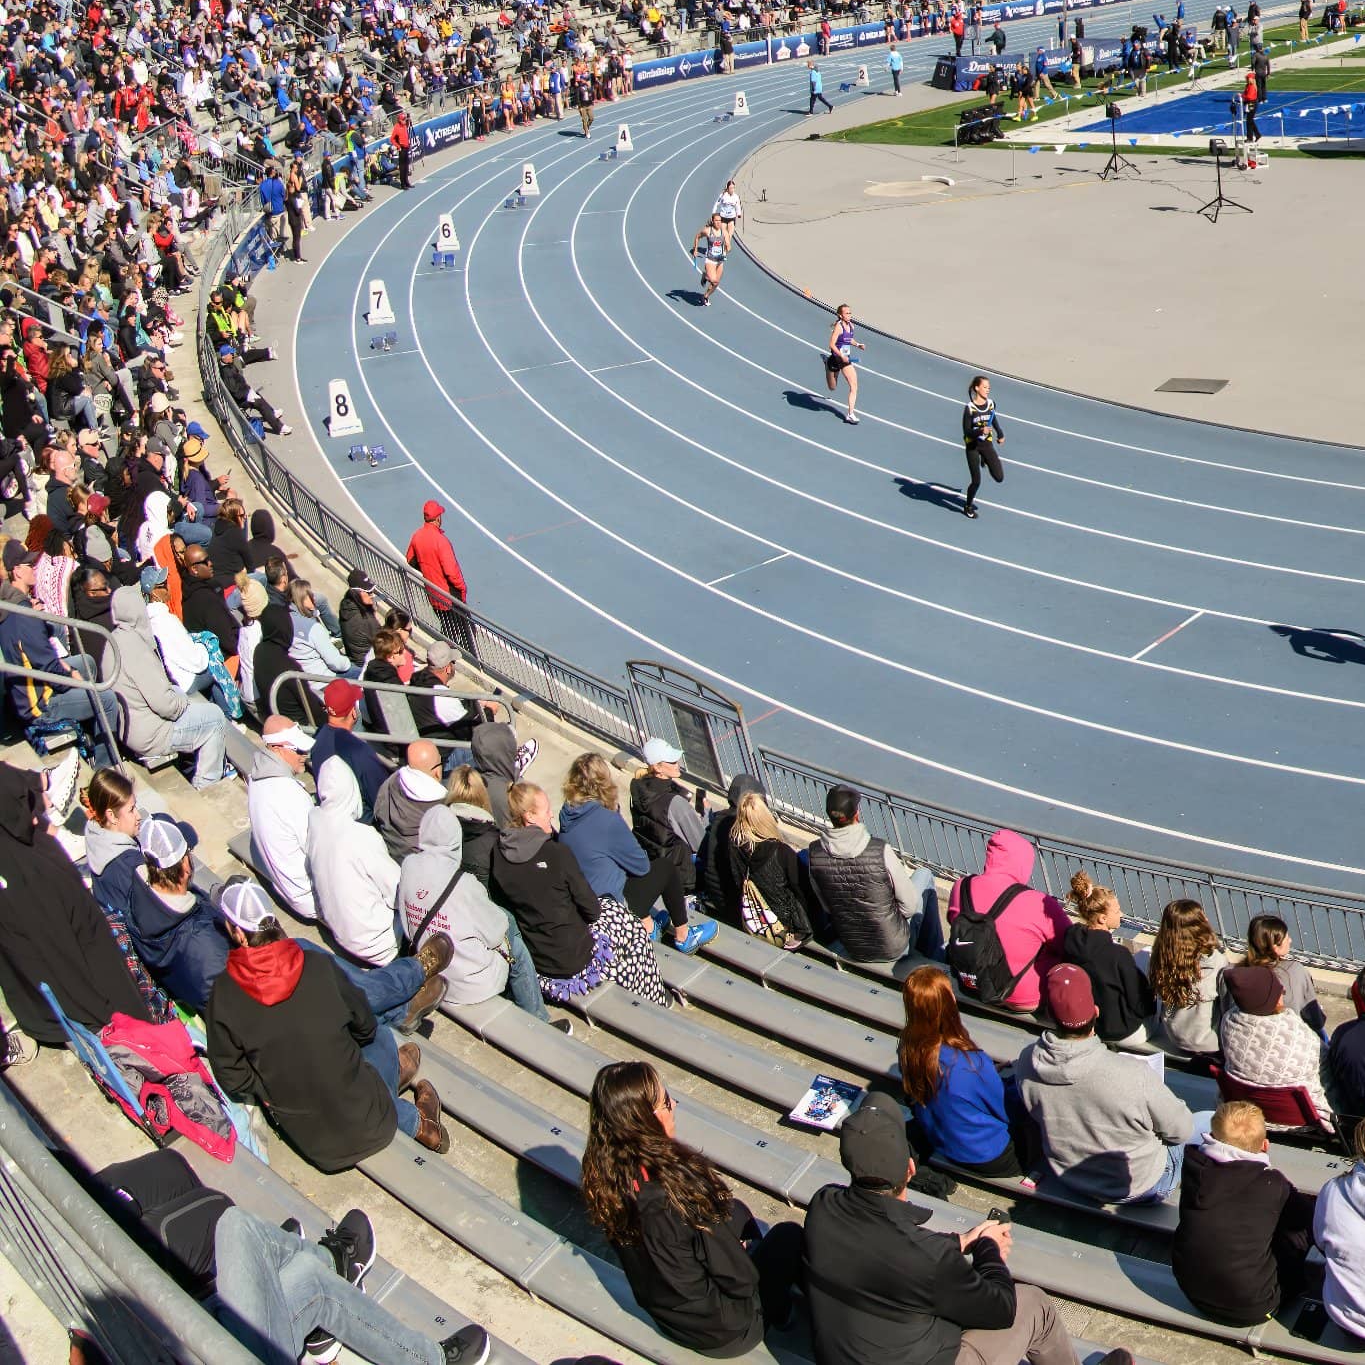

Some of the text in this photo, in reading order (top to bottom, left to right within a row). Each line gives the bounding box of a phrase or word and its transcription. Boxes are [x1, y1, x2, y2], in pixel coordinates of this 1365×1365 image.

[859, 70, 865, 80] 2
[738, 97, 744, 107] 3
[620, 130, 627, 142] 4
[525, 171, 532, 184] 5
[441, 223, 451, 238] 6
[372, 291, 382, 309] 7
[335, 394, 348, 416] 8
[550, 1127, 562, 1135] 22
[756, 1140, 768, 1148] 21
[434, 1316, 446, 1325] 20
